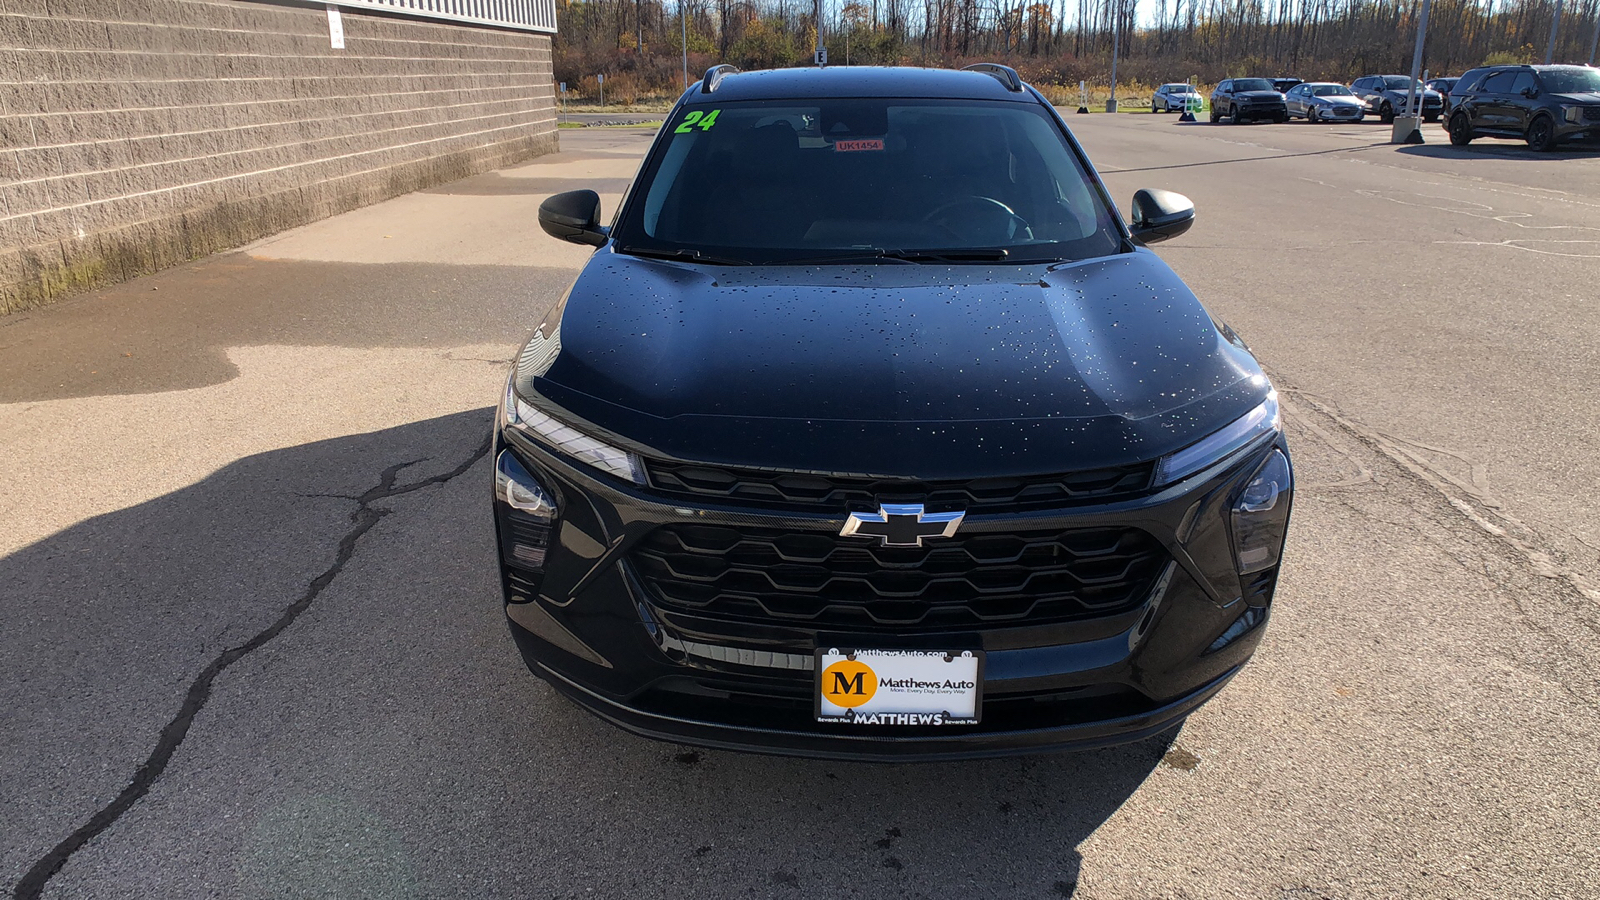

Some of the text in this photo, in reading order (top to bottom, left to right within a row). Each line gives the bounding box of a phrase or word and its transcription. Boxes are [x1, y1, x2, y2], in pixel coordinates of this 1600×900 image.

[818, 51, 824, 63] E
[674, 109, 721, 133] 24
[839, 141, 879, 150] UK1454
[853, 649, 948, 658] MatthewsAuto.com
[830, 671, 867, 695] M
[879, 677, 975, 689] Matthews Auto
[853, 713, 943, 726] MATTHEWS
